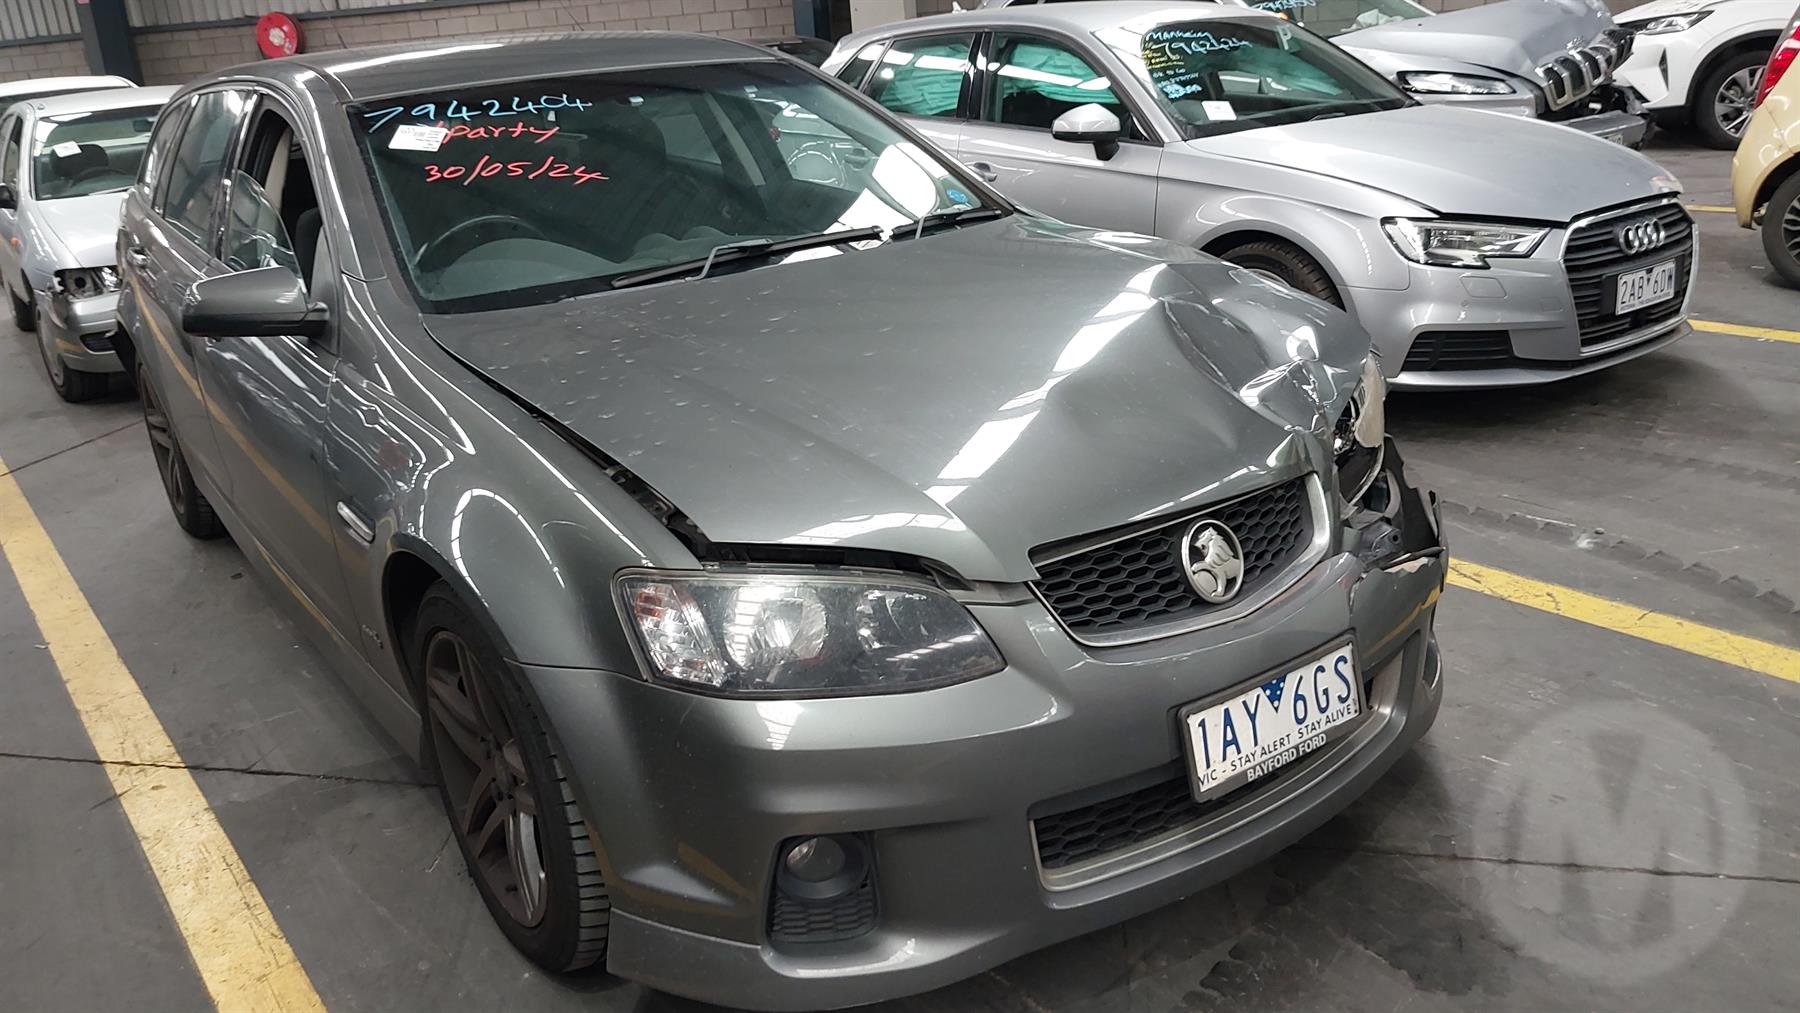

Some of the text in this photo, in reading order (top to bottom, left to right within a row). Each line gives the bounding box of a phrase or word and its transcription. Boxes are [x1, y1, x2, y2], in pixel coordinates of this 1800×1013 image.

[364, 93, 593, 133] 7942404
[424, 154, 610, 185] 30/05/24
[1621, 276, 1644, 304] 2AB
[1198, 655, 1351, 770] 1AY 6GS
[1198, 771, 1218, 786] VIC
[1230, 751, 1258, 772] STAY
[1260, 734, 1292, 757] ALERT
[1297, 719, 1322, 740] STAY
[1324, 704, 1352, 726] ALIVE
[1247, 733, 1327, 782] BAYFORD FORD
